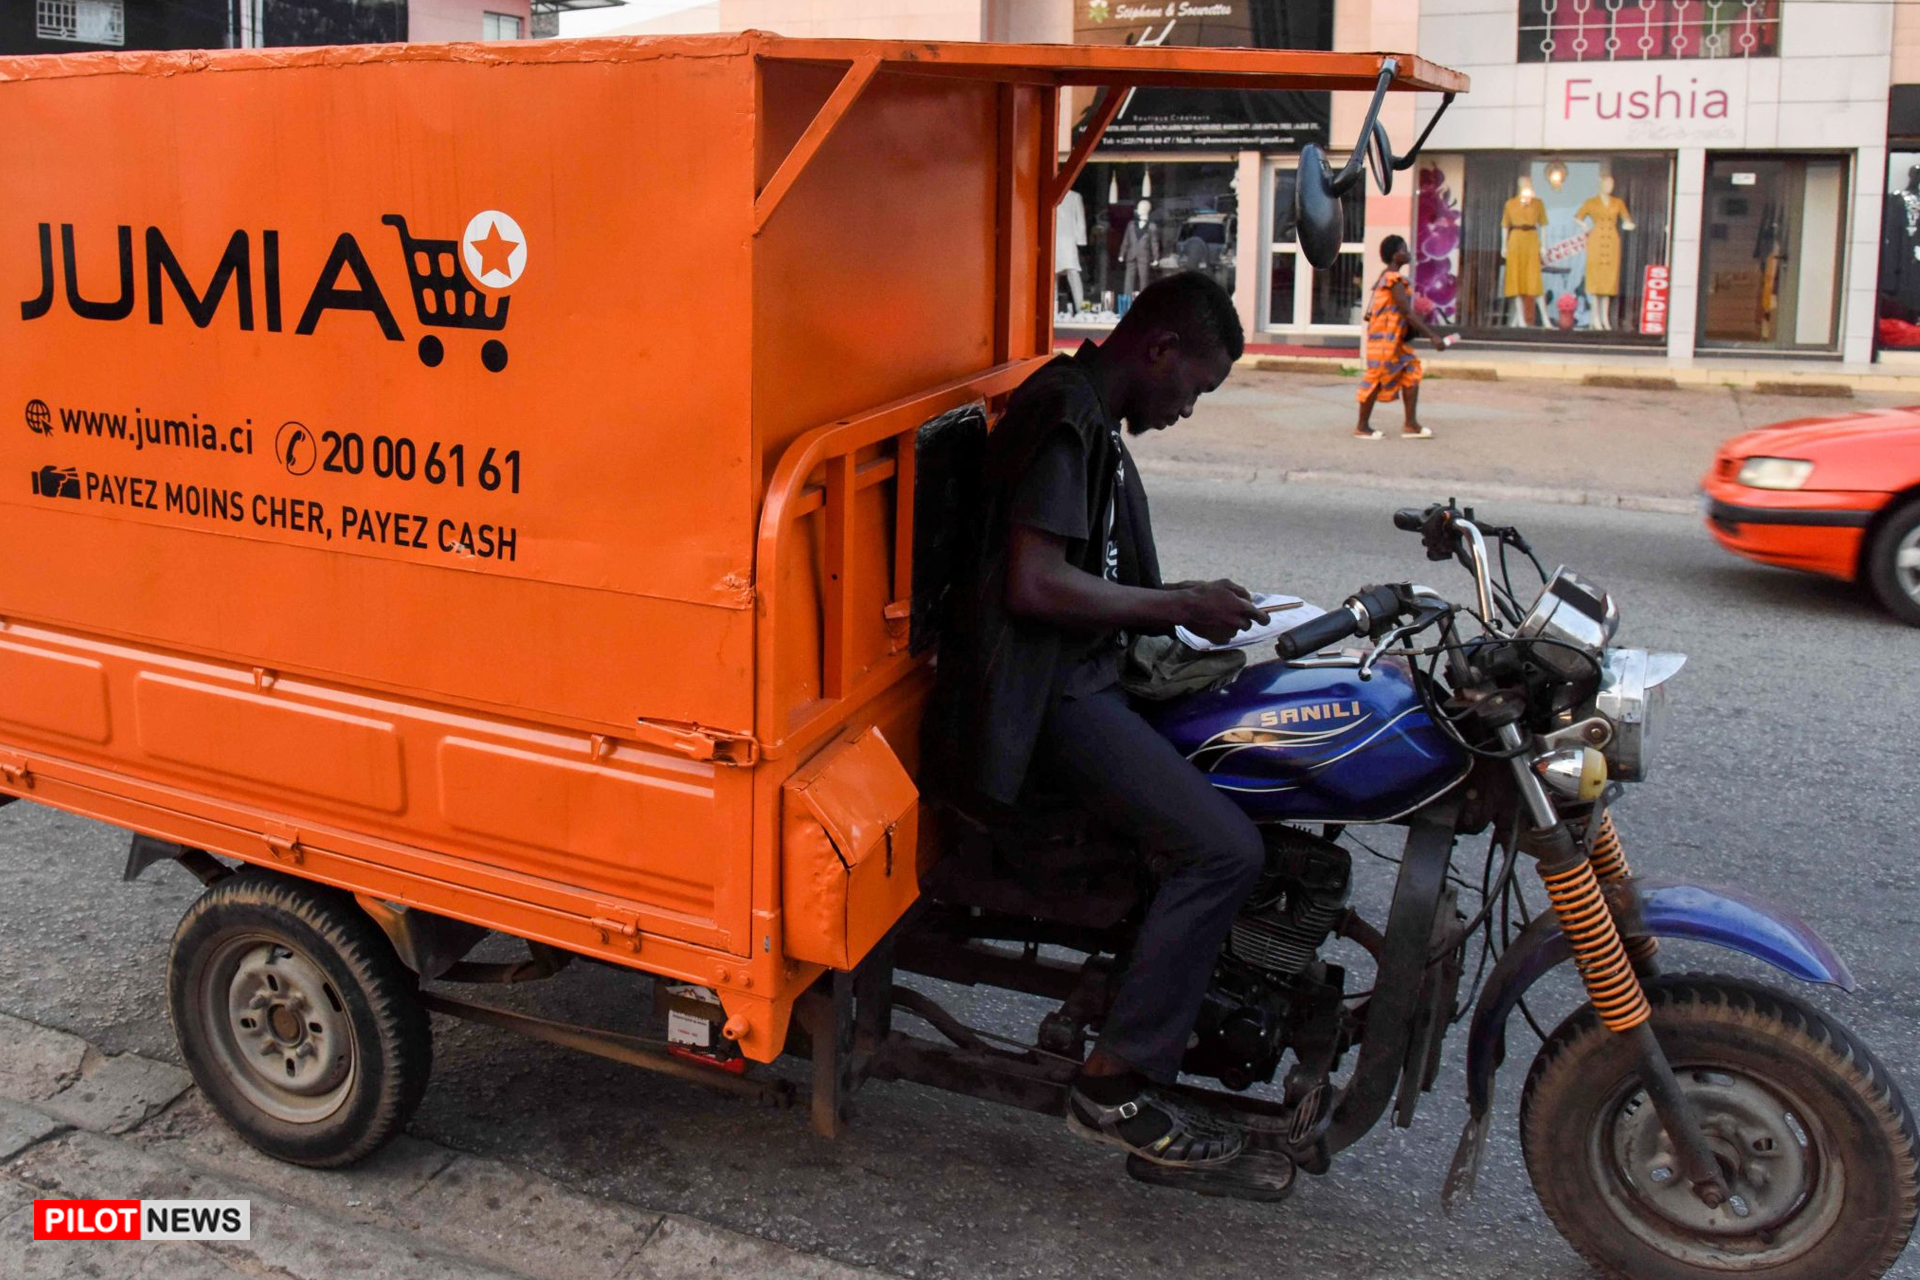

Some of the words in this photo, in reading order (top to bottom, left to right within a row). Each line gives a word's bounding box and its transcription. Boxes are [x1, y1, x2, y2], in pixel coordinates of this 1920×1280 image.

[1165, 2, 1176, 17] &
[1564, 75, 1728, 120] Fushia
[21, 223, 404, 341] JUMIA
[1643, 267, 1668, 333] SOLDES
[60, 408, 253, 455] www.jumia.ci
[322, 431, 363, 474] 20
[374, 436, 415, 480] 00
[425, 442, 463, 486] 61
[479, 448, 520, 493] 61
[87, 473, 157, 509] PAYEZ
[166, 483, 243, 521] MOINS
[253, 495, 331, 539] CHER,
[343, 507, 427, 548] PAYEZ
[439, 520, 516, 560] CASH
[1260, 700, 1360, 727] SANILI
